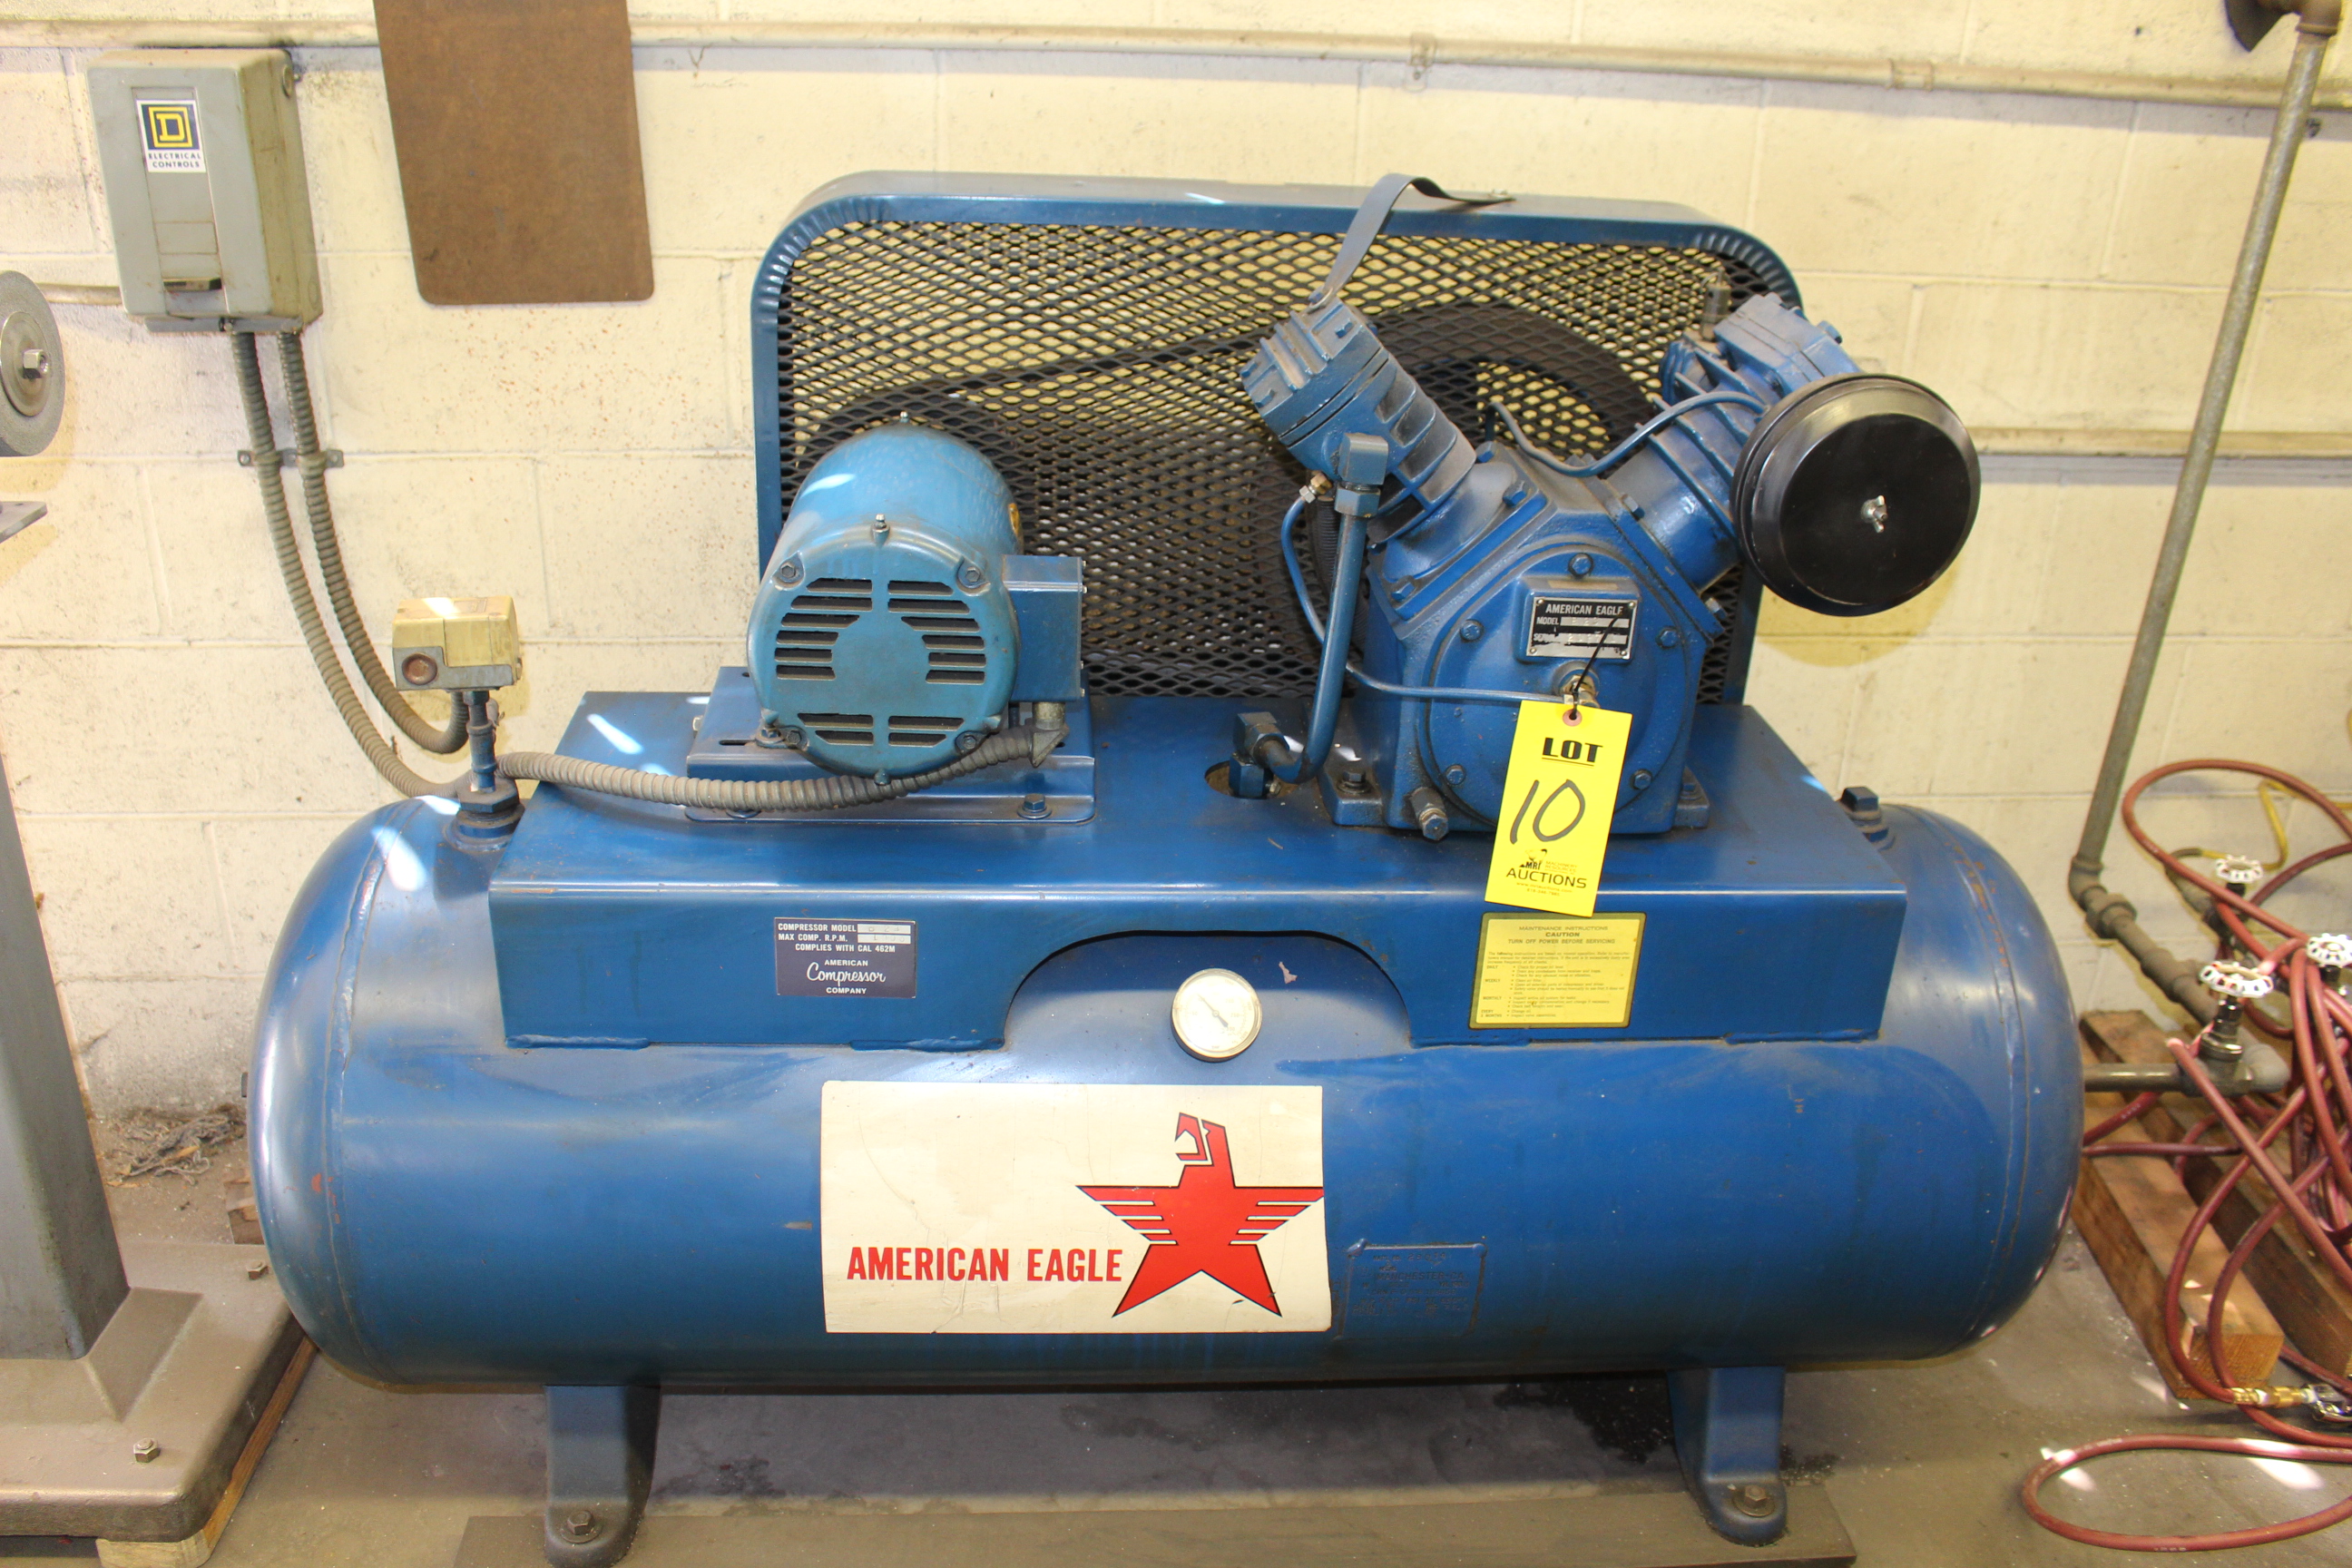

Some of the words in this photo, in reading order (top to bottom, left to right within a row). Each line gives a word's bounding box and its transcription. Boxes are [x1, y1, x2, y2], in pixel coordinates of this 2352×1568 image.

[1545, 603, 1592, 615] AMERICAN
[1536, 617, 1559, 625] MODEL
[1542, 737, 1603, 763] LOT
[1509, 779, 1586, 844] 10
[1525, 860, 1543, 870] MRI
[1506, 868, 1587, 888] AUCTIONS
[778, 923, 828, 931] COMPRESSOR
[806, 962, 886, 986] Compressor
[847, 1246, 1009, 1282] AMERICAN
[1027, 1249, 1122, 1282] EAGLE
